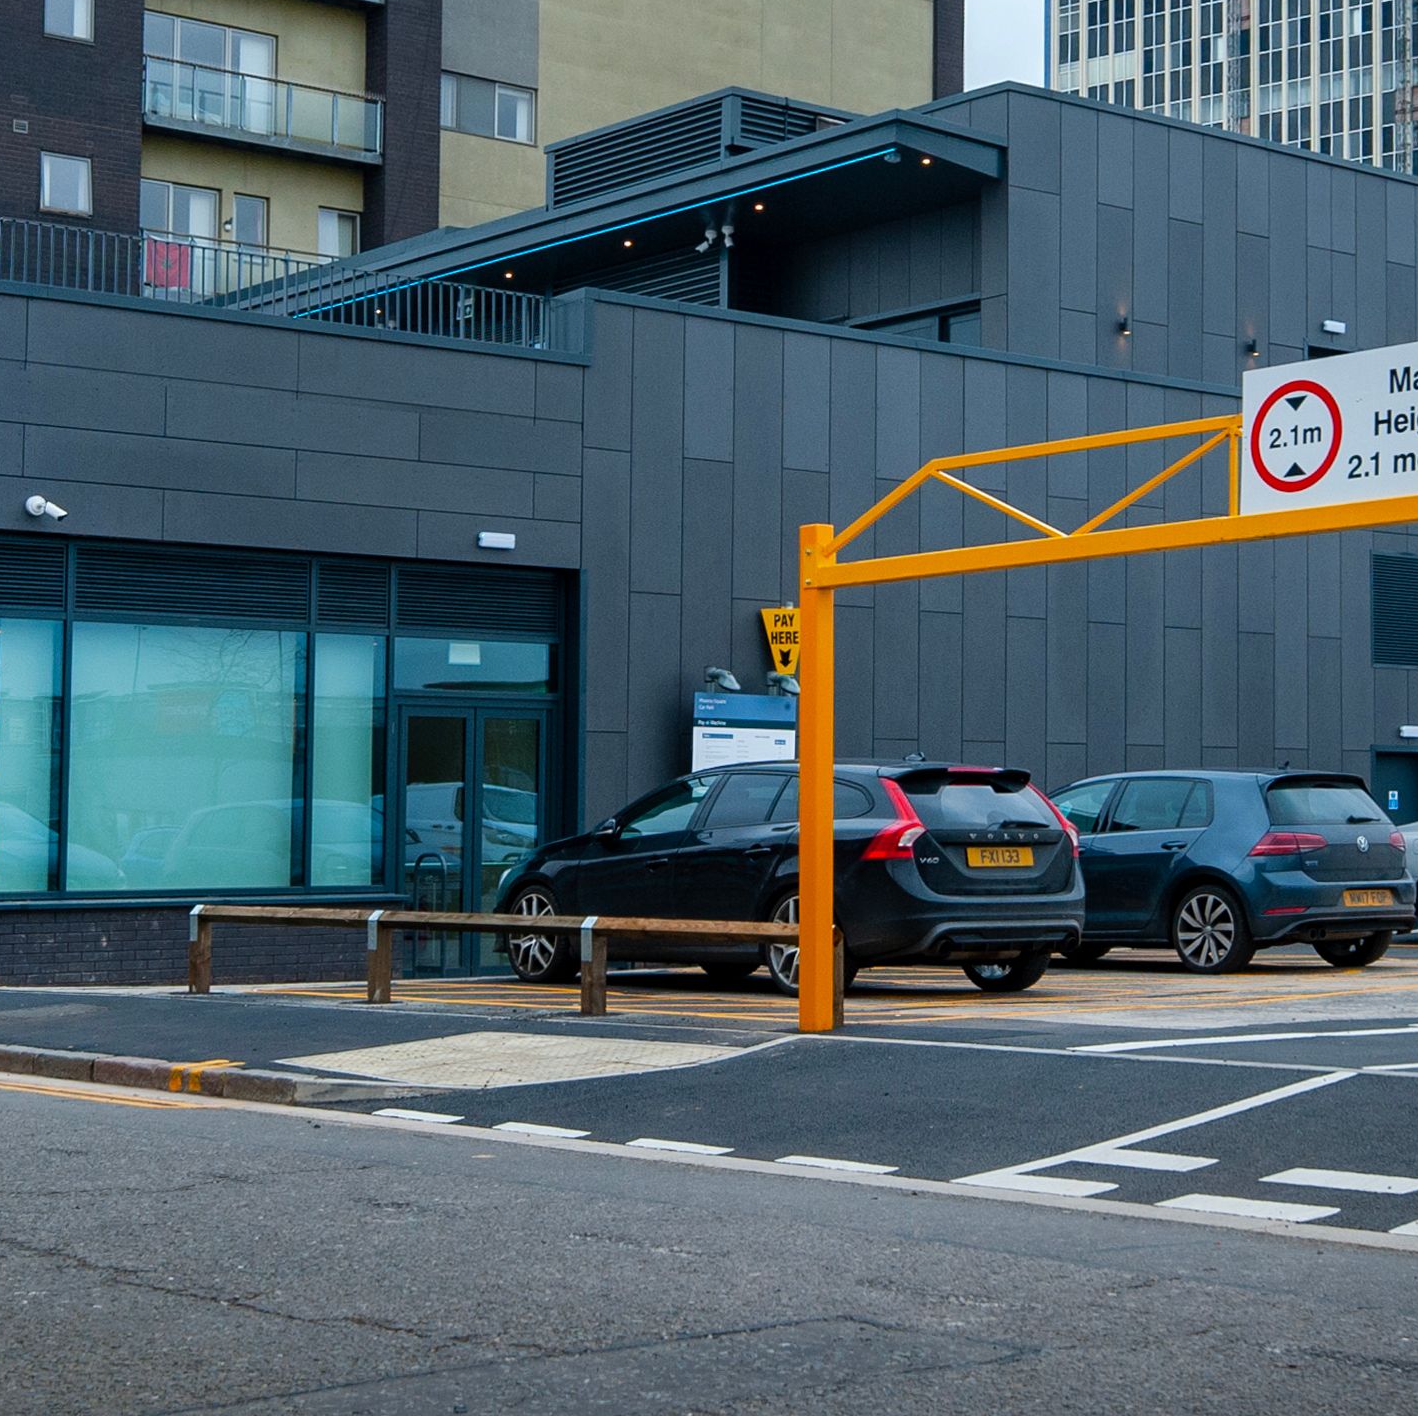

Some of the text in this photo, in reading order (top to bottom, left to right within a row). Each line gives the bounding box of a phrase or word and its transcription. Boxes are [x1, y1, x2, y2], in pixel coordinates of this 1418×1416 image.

[1269, 425, 1322, 450] 2.1m
[1347, 452, 1380, 480] 2.1
[774, 613, 794, 628] PAY
[771, 631, 799, 645] HERE
[969, 832, 1039, 840] VOLVO
